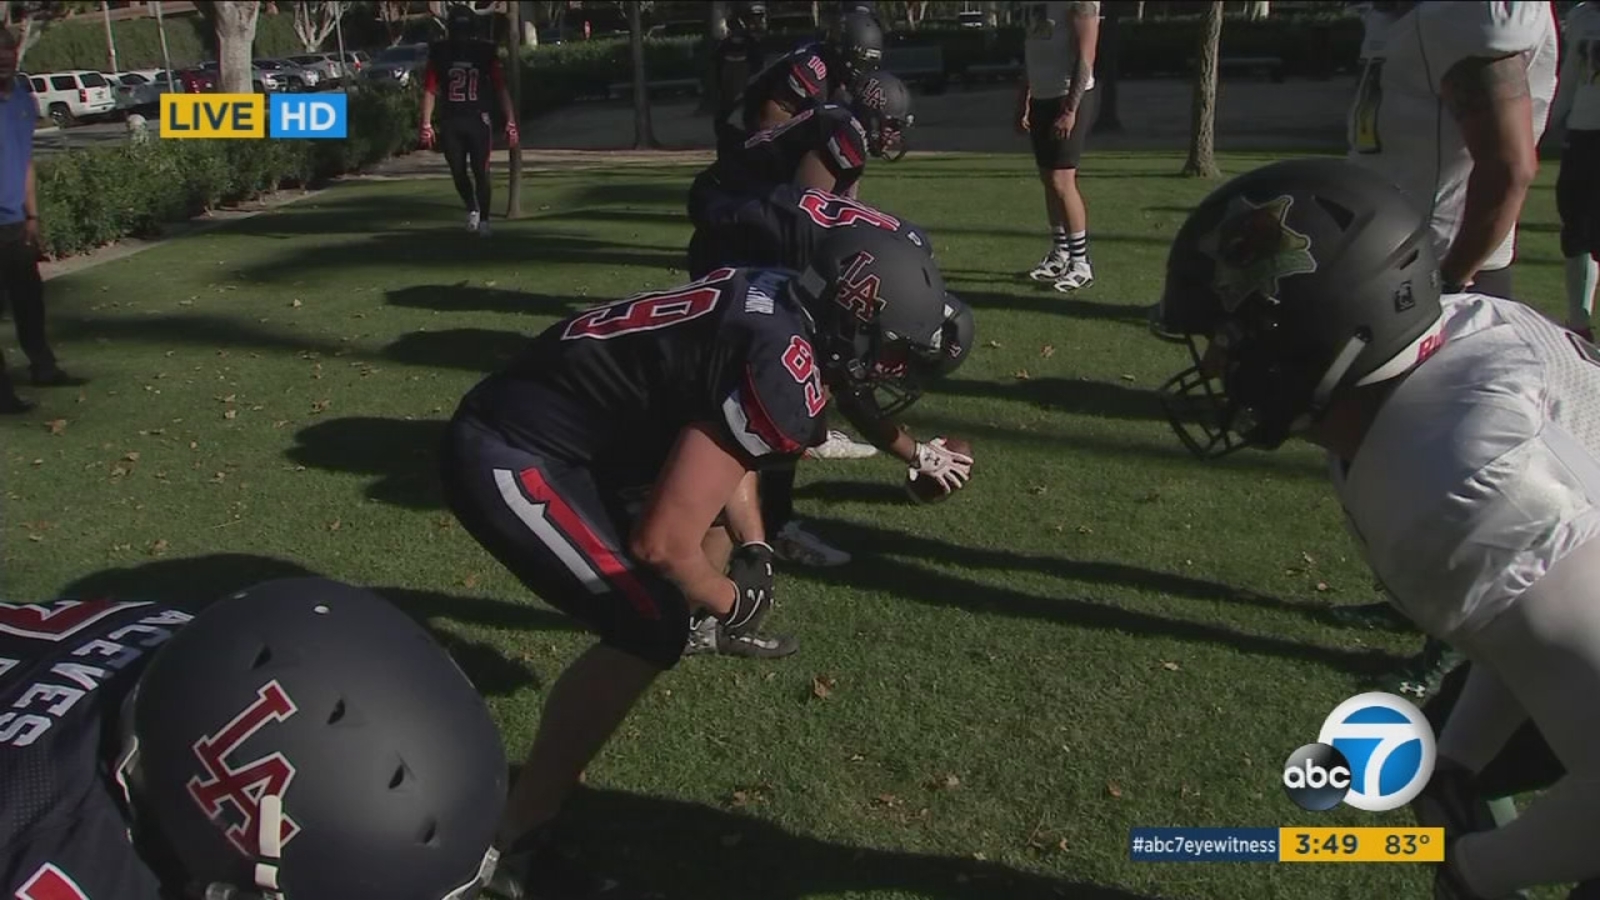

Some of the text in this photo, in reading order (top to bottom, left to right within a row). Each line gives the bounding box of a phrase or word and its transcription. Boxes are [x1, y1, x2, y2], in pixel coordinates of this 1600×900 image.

[447, 67, 480, 101] 21
[860, 78, 888, 110] LA
[835, 250, 887, 322] LA
[0, 610, 196, 747] ACEVES
[186, 678, 302, 858] LA
